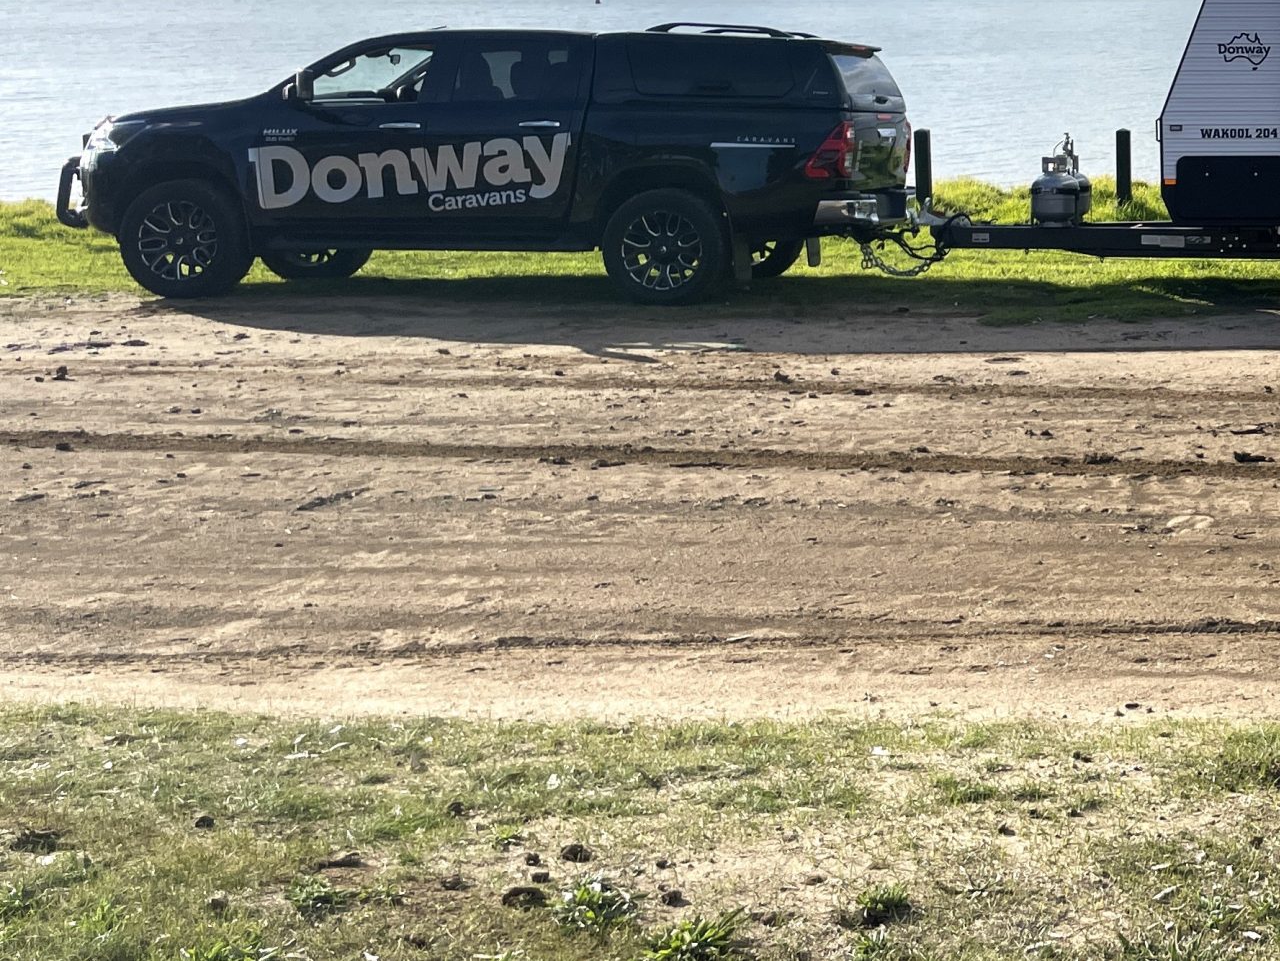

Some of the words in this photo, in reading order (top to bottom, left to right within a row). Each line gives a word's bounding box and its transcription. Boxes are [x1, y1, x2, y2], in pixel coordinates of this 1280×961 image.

[1217, 43, 1271, 57] Donway
[736, 136, 796, 144] CARAVANS
[1200, 128, 1252, 139] WAKOOL
[1255, 128, 1278, 139] 204
[248, 132, 571, 209] Donway
[427, 189, 527, 212] Caravans
